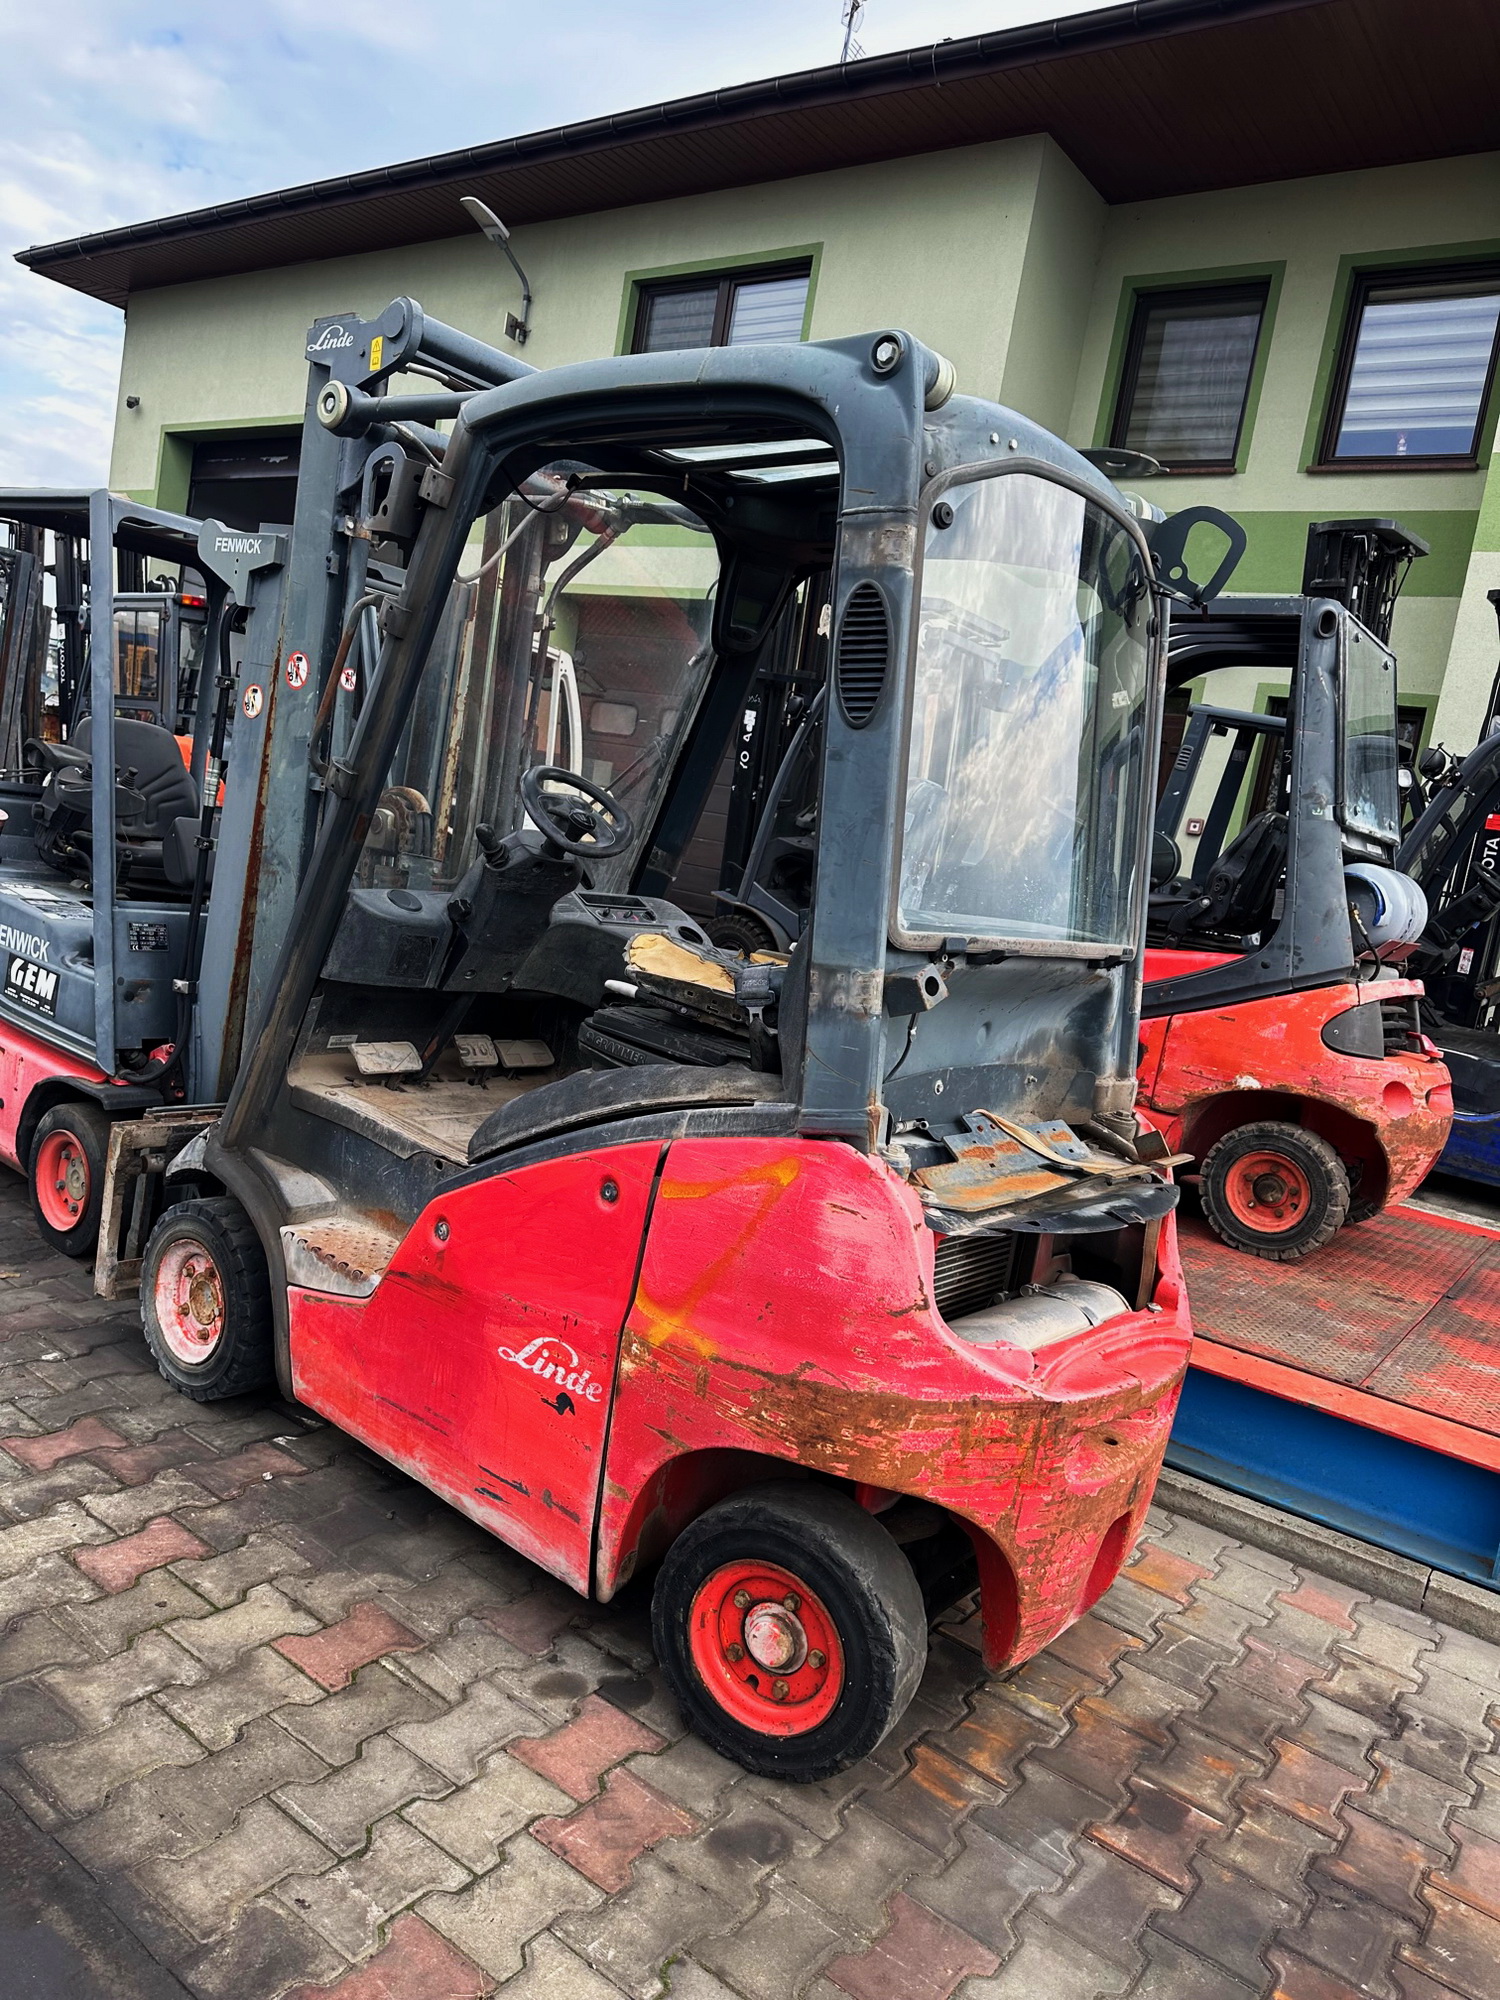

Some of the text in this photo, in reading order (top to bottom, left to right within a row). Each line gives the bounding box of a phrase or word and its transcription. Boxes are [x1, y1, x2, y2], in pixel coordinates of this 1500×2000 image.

[307, 325, 354, 351] Linde
[214, 537, 262, 554] FENWICK
[1480, 837, 1500, 877] OTA
[0, 924, 50, 962] ENWICK
[498, 1336, 602, 1402] Linde
